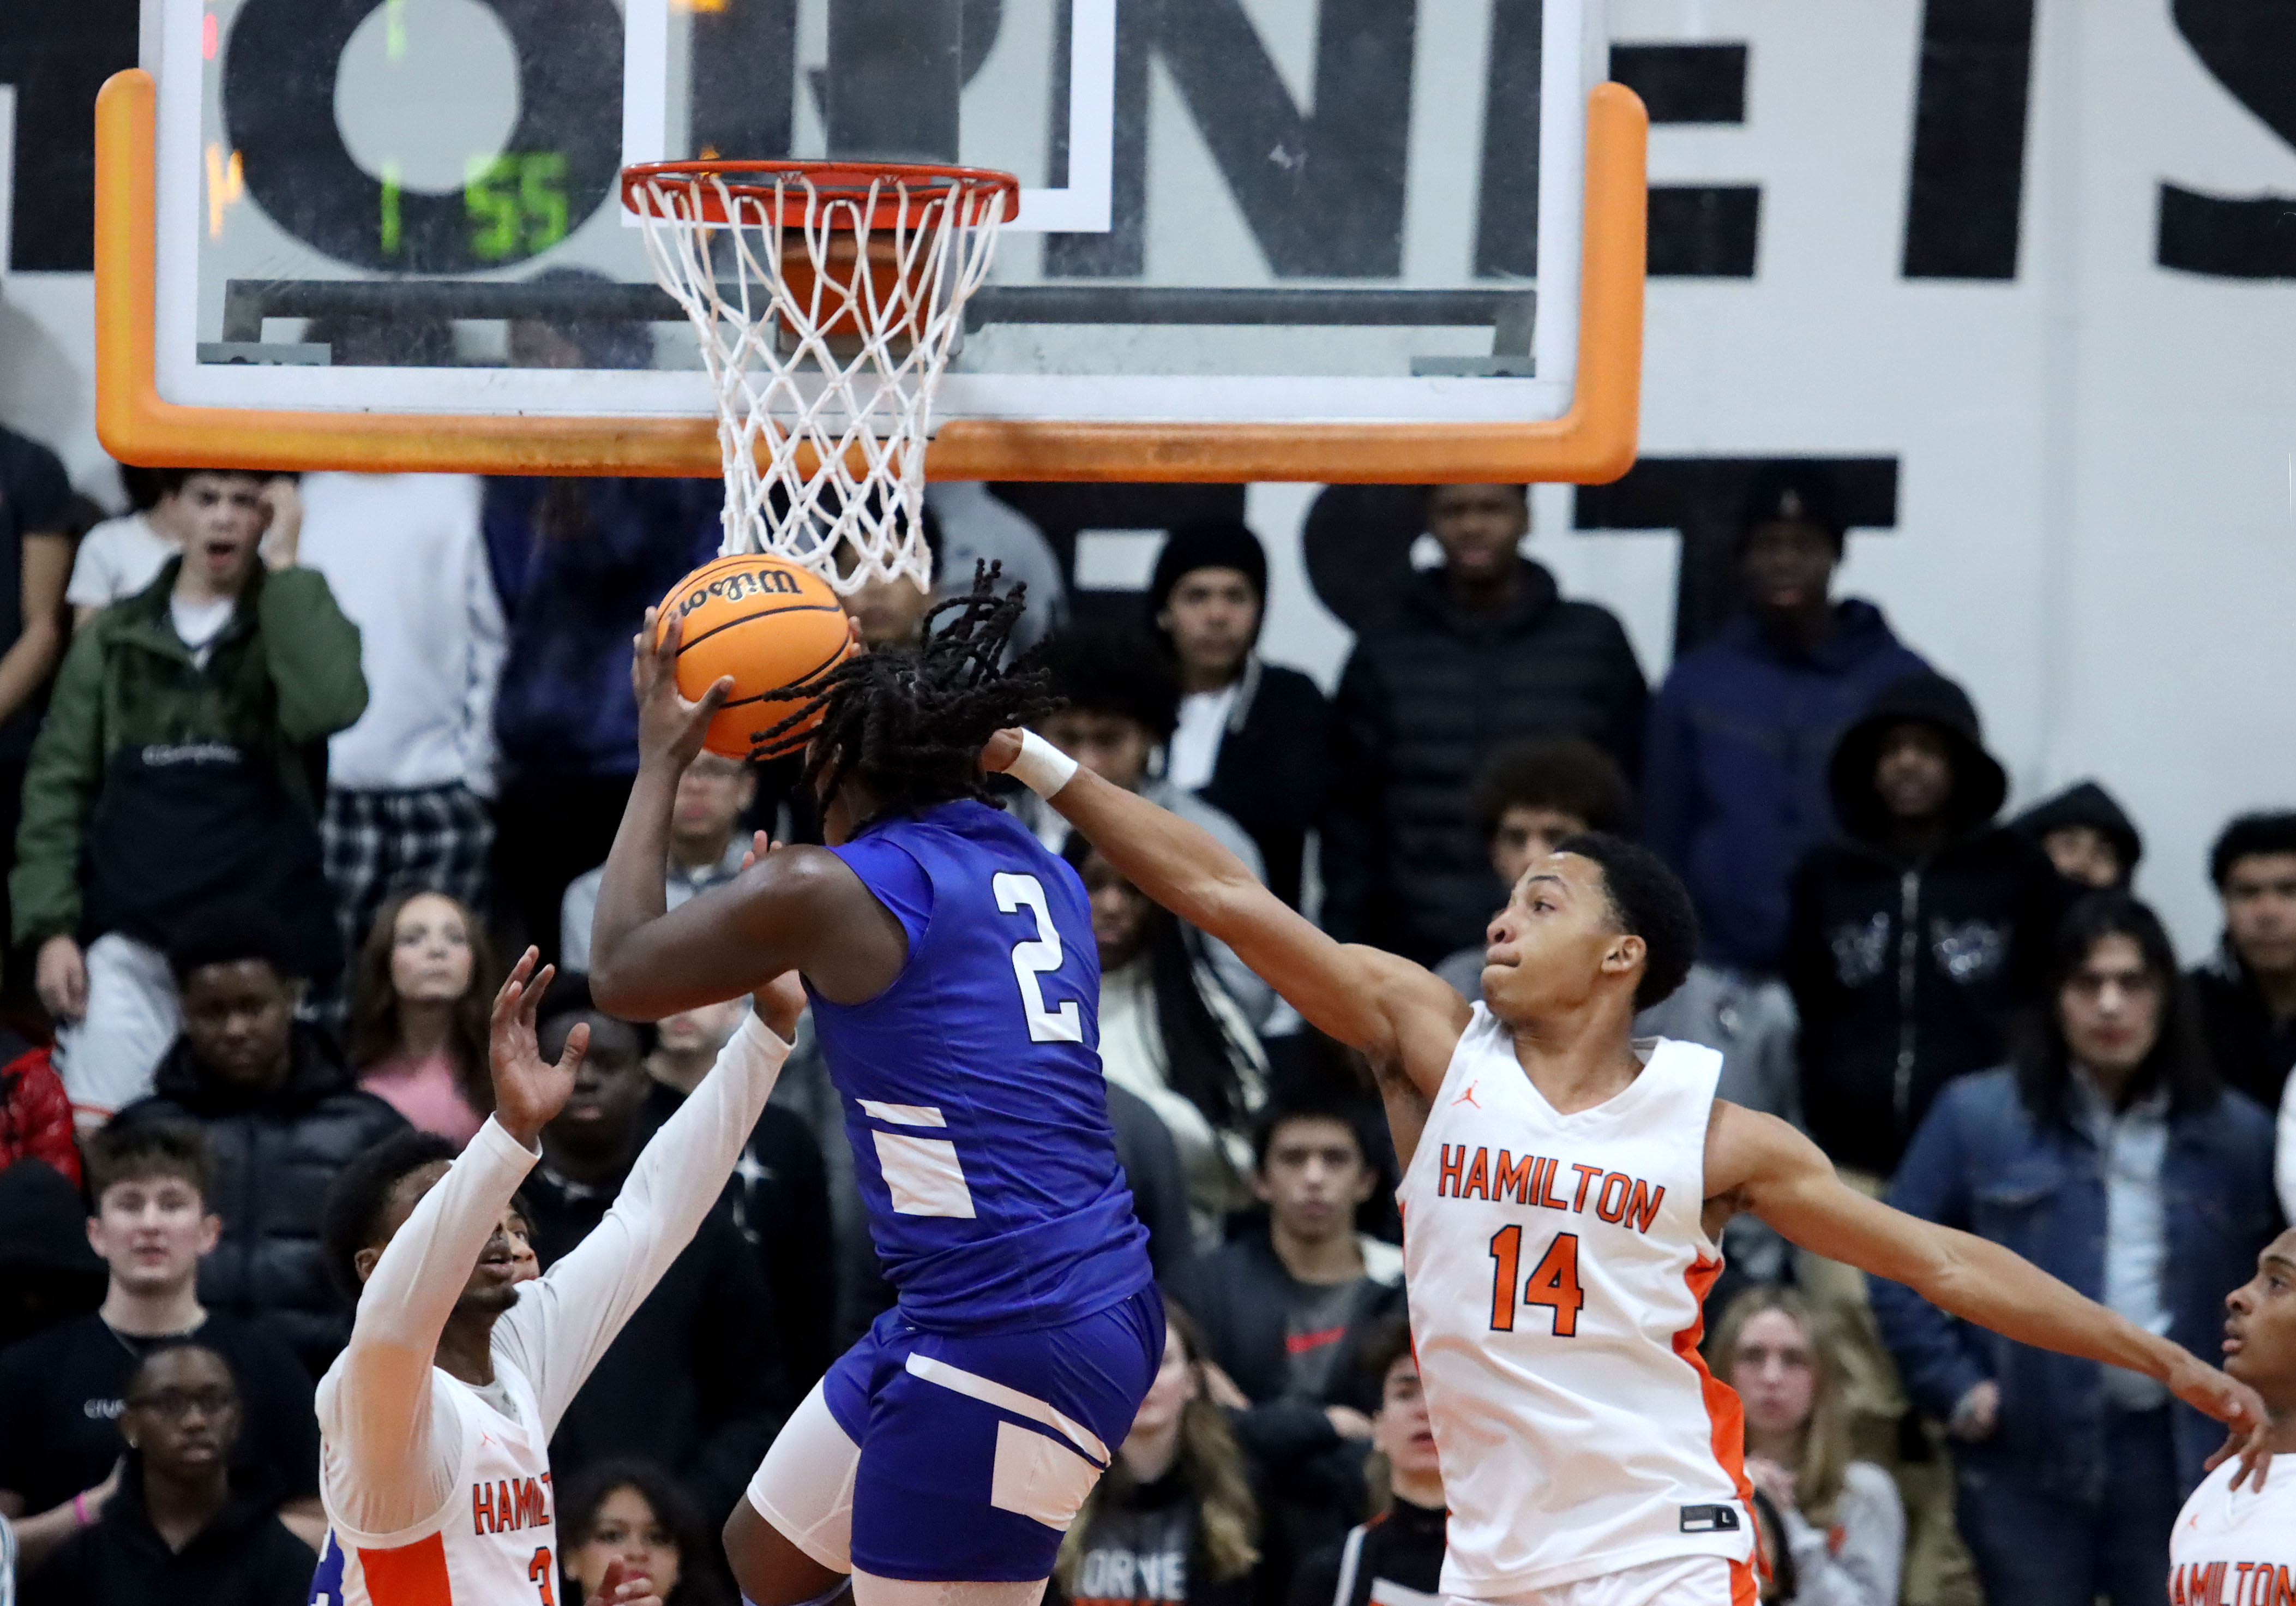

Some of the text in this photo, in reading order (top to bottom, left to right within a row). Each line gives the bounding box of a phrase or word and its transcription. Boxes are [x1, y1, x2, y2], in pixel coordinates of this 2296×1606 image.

[992, 871, 1083, 1042] 2
[1438, 1143, 1666, 1234] HAMILTON
[1489, 1224, 1584, 1338] 14
[1721, 1511, 1730, 1524] L
